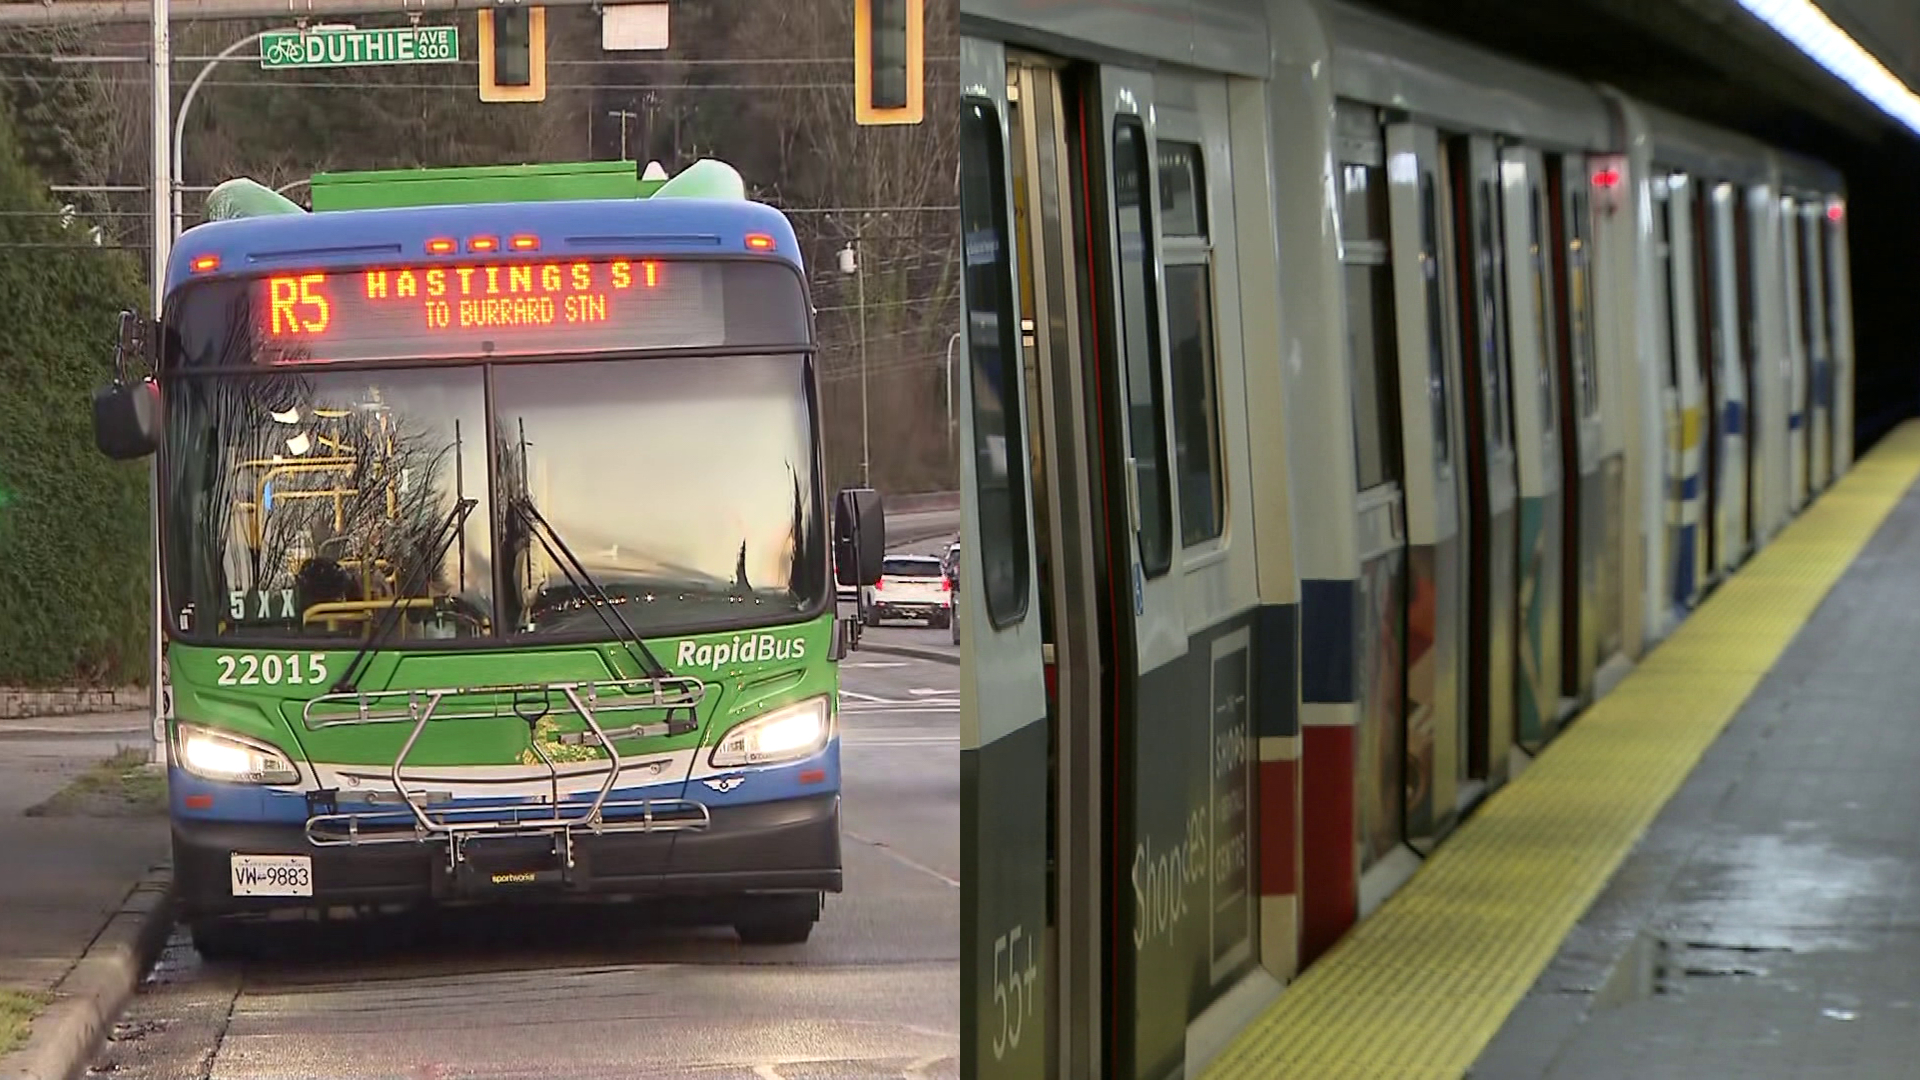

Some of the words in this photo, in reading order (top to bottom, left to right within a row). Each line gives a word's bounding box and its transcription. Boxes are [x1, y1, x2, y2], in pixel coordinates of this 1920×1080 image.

[306, 32, 414, 62] DUTHIE
[418, 31, 448, 45] AVE
[418, 45, 449, 58] 300
[367, 264, 591, 298] HASTINGS
[270, 274, 330, 334] R5
[425, 301, 449, 328] TO
[460, 296, 555, 326] BURRARD
[564, 294, 606, 323] STN
[216, 653, 328, 686] 22015
[677, 633, 806, 672] RapidBus
[992, 924, 1037, 1061] 55+
